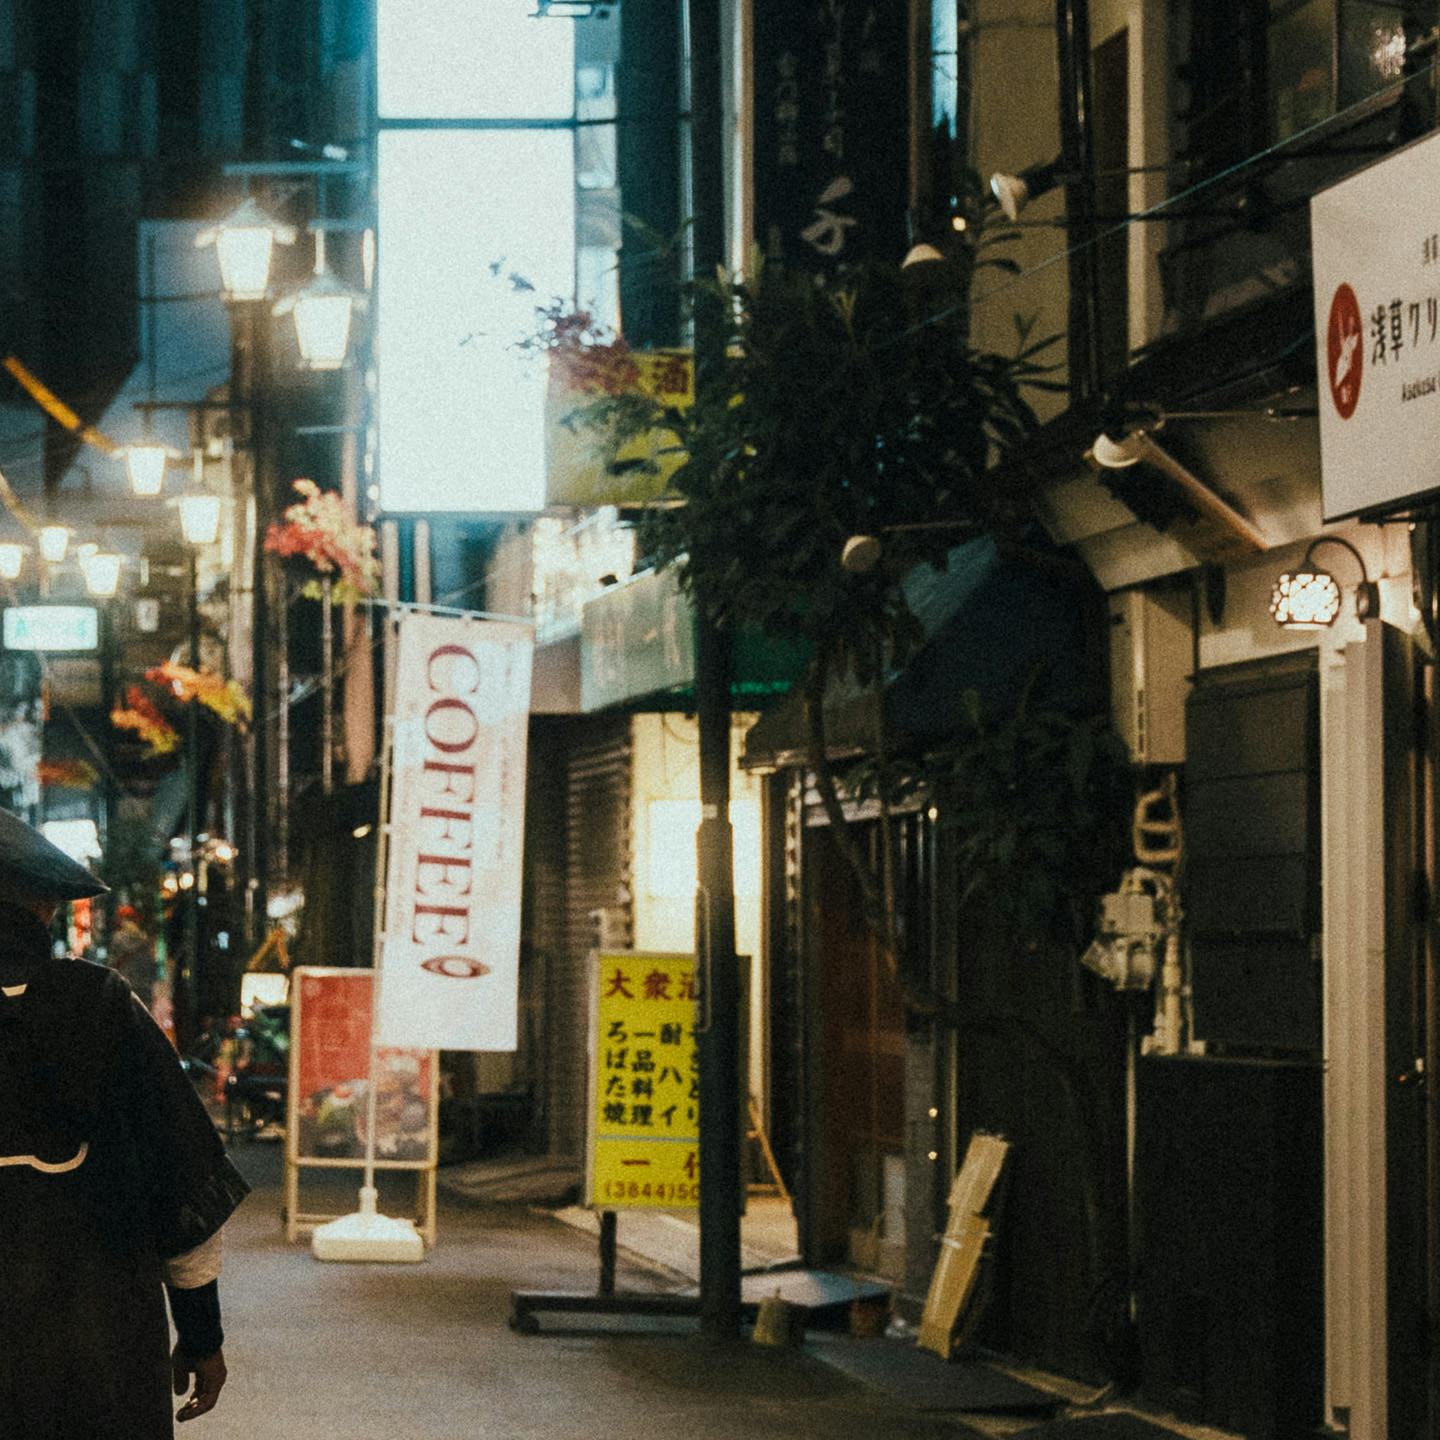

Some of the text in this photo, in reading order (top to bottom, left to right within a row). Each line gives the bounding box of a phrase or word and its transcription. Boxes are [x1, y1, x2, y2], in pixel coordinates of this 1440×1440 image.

[411, 644, 481, 946] COFFEE
[603, 1021, 628, 1126] ろばた焼
[630, 1030, 656, 1127] 一品料理
